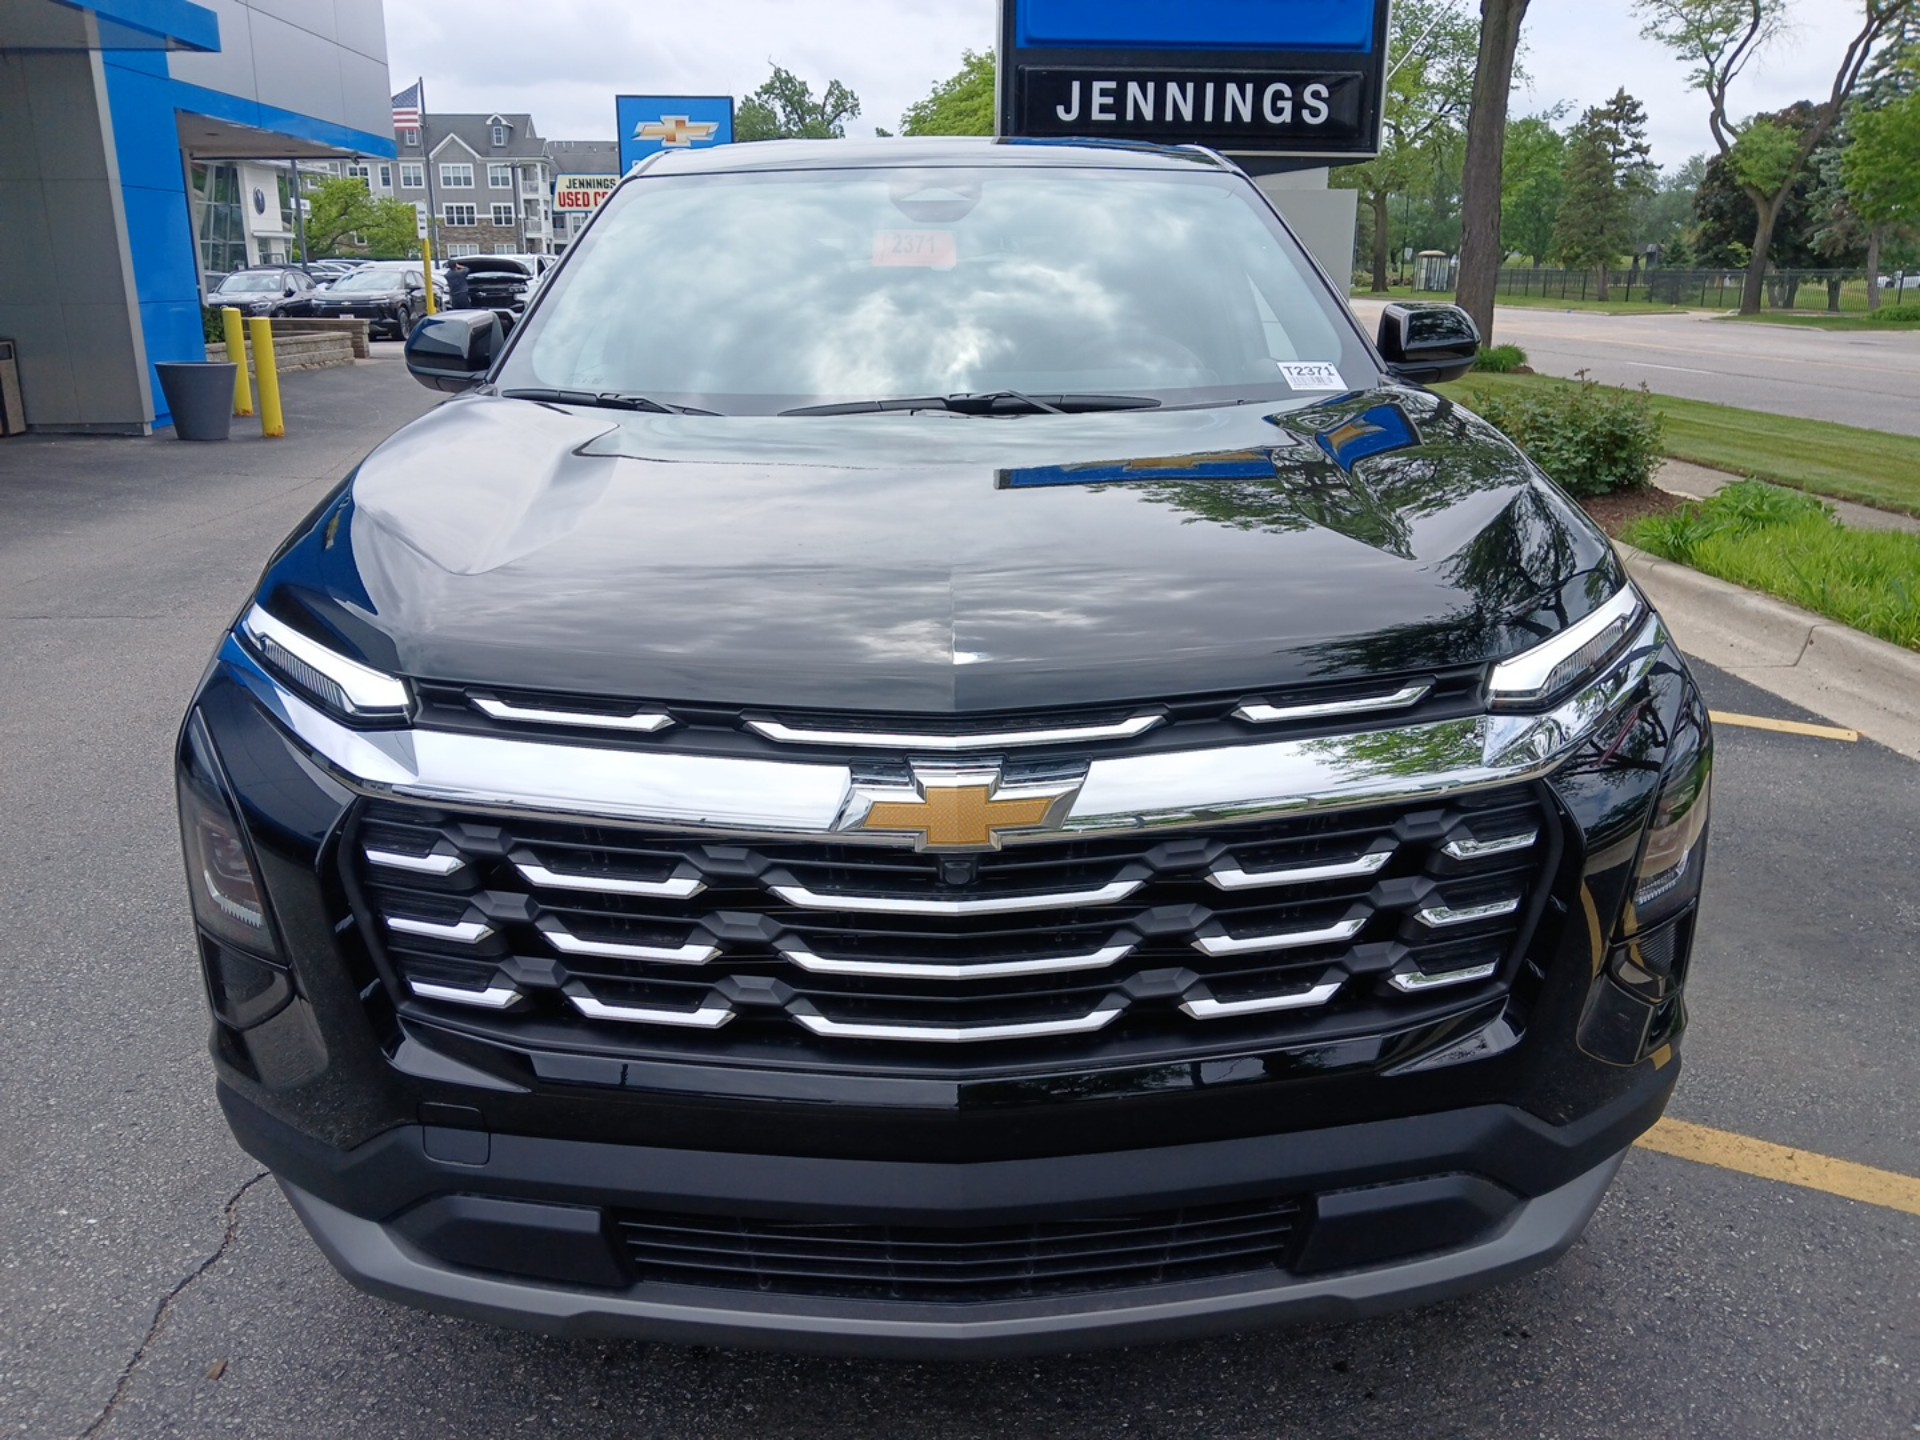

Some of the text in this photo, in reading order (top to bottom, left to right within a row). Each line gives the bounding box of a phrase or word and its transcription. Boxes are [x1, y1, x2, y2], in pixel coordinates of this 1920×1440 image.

[1055, 80, 1330, 125] JENNINGS
[566, 178, 617, 189] JENNINGS
[558, 191, 590, 208] USED
[892, 233, 935, 254] 2371
[1282, 366, 1335, 377] T2371
